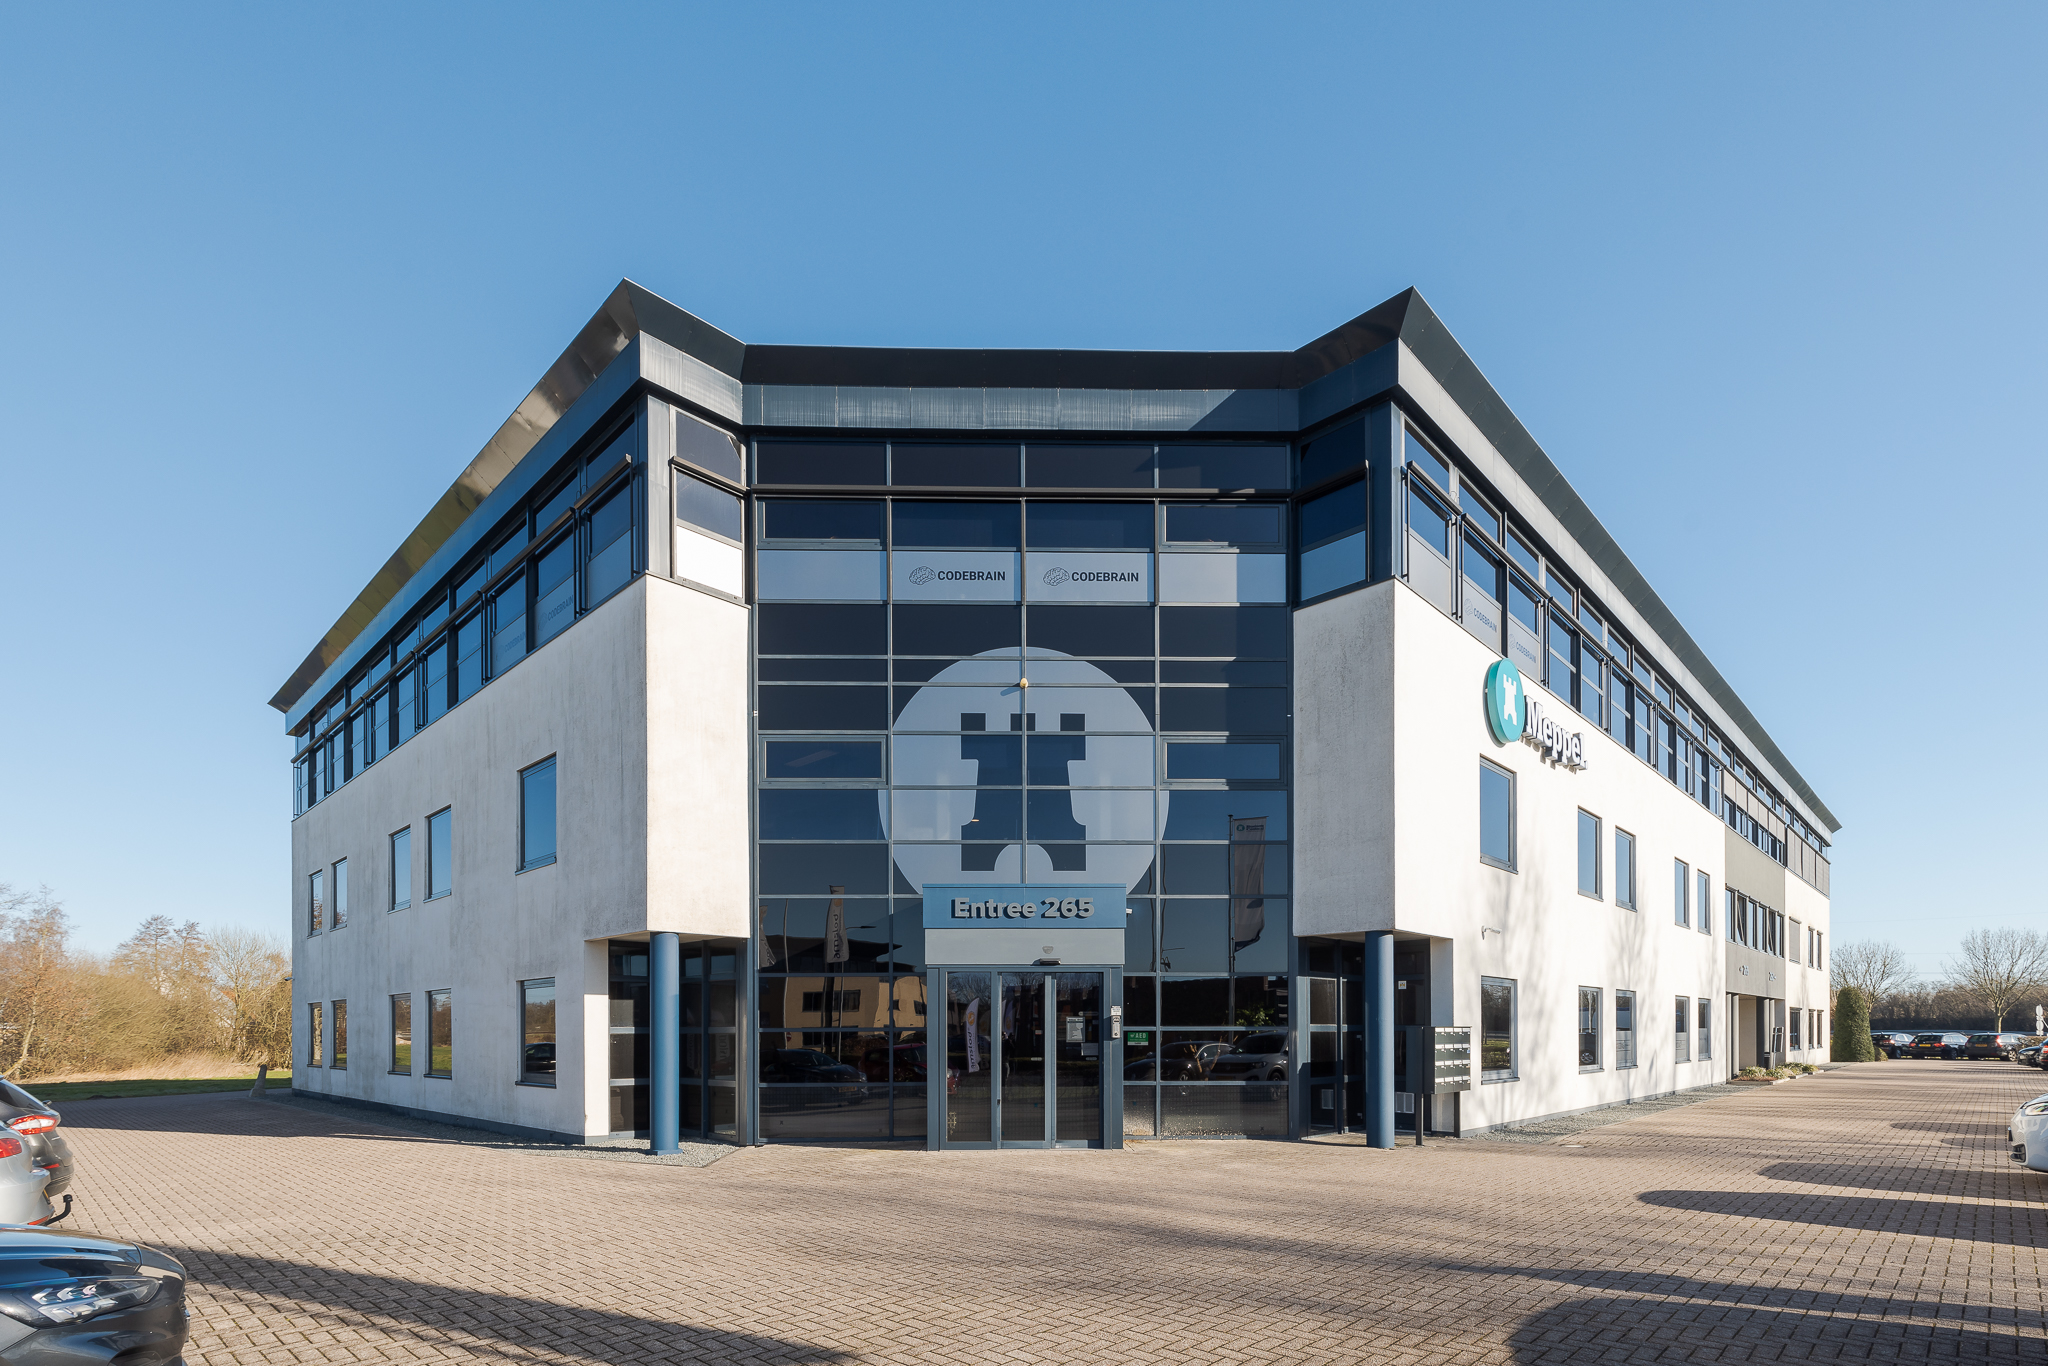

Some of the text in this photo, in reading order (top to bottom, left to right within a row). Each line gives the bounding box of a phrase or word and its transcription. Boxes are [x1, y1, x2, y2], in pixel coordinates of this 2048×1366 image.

[937, 570, 1006, 581] CODEBRAIN
[1071, 571, 1139, 582] CODEBRAIN
[547, 594, 574, 621] CODEBRAIN
[1473, 608, 1497, 633] CODEBRAIN
[1515, 641, 1537, 664] CODEBRAIN
[1524, 694, 1588, 770] Meppel
[953, 897, 1095, 918] Entree 265
